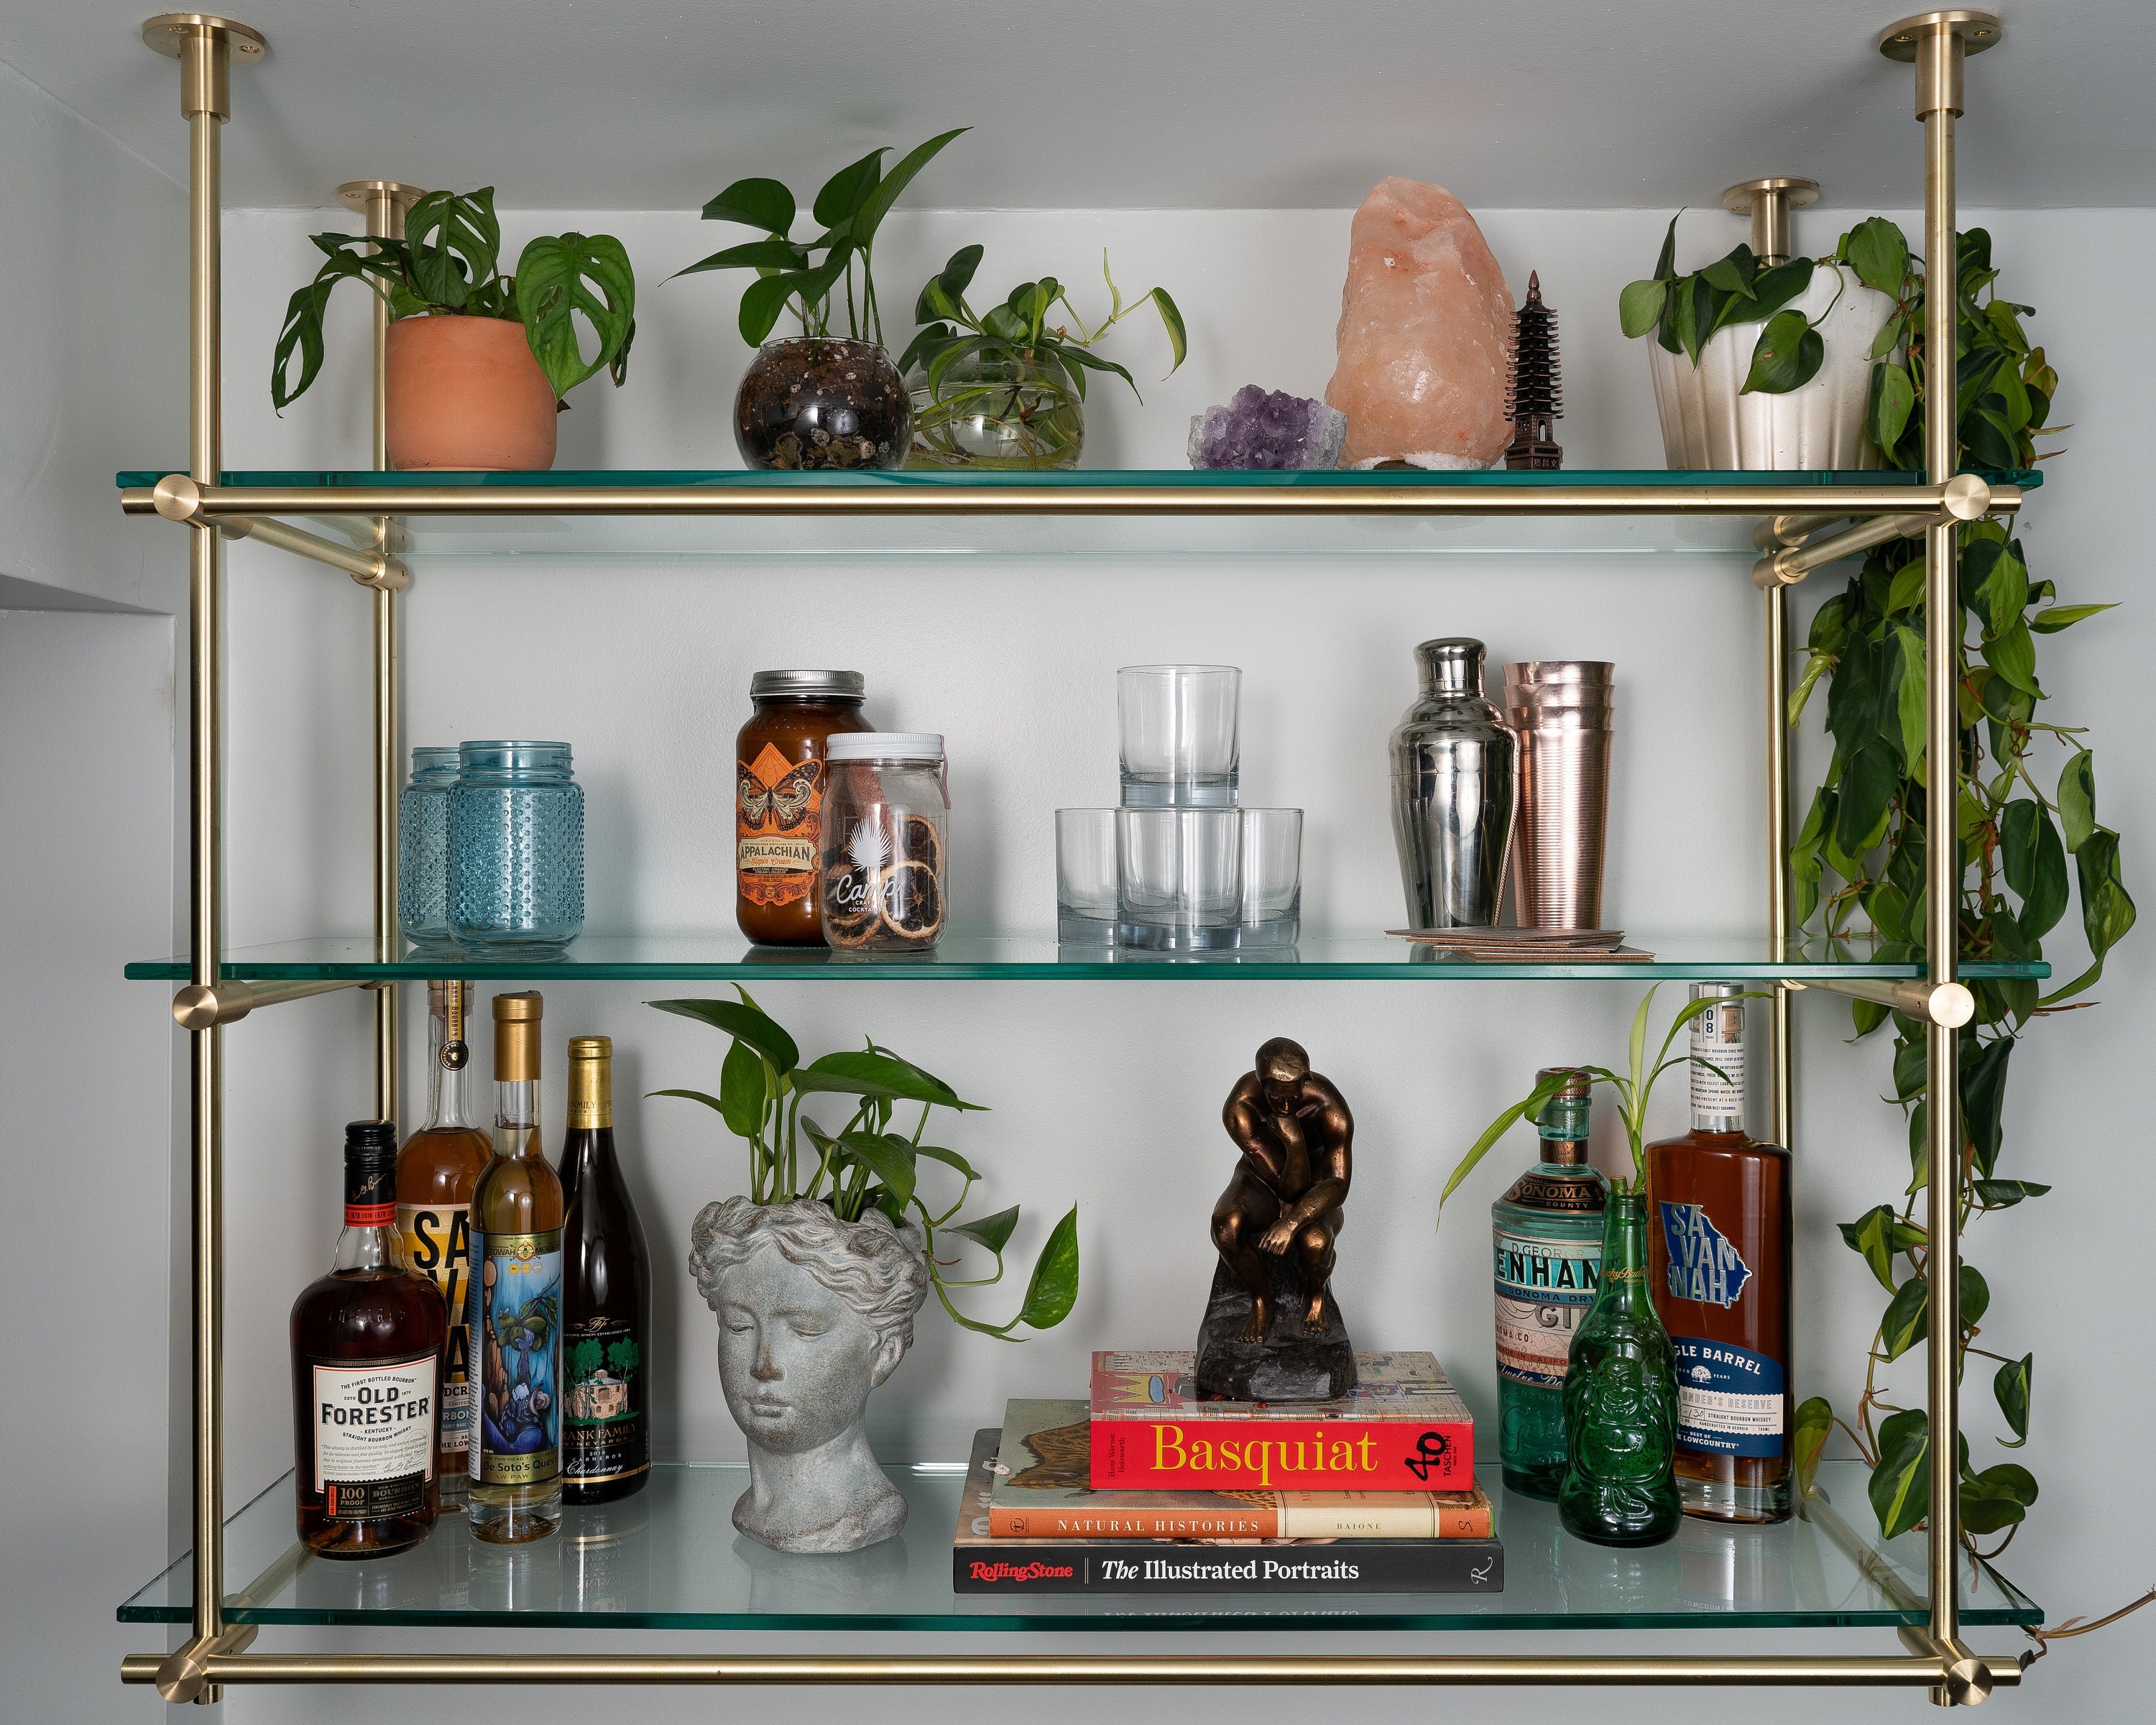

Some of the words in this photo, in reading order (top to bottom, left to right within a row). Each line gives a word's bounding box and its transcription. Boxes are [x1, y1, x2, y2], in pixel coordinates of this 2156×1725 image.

[740, 846, 811, 862] APPALACHIAN
[750, 857, 770, 866] Sippin'
[770, 857, 791, 866] Cream
[837, 874, 901, 907] Camp
[570, 1100, 596, 1109] FAMILY
[1506, 1179, 1592, 1200] SONOMA
[1671, 1205, 1705, 1238] SA
[1679, 1236, 1736, 1271] VAN
[1671, 1266, 1727, 1303] NAH
[1508, 1287, 1561, 1302] SONOMA
[1534, 1305, 1580, 1329] GI
[1496, 1325, 1513, 1338] NOMA
[1518, 1333, 1533, 1343] CO.
[1498, 1346, 1514, 1356] MADE
[1531, 1356, 1567, 1365] CALIFO
[1674, 1345, 1697, 1357] GLE
[1703, 1347, 1761, 1375] BARREL
[351, 1379, 367, 1388] FIRST
[444, 1386, 469, 1397] DCR
[357, 1386, 400, 1404] OLD
[1682, 1391, 1723, 1407] UNDER'S
[1728, 1398, 1772, 1409] RESERVE
[342, 1432, 367, 1443] STRAIGHT
[368, 1434, 393, 1443] BOURBON
[393, 1425, 412, 1438] WHISKY
[364, 1426, 393, 1435] KENTUCKY
[598, 1423, 635, 1439] FAMILY
[564, 1437, 628, 1447] VINEYARDS
[483, 1461, 495, 1471] De
[497, 1462, 530, 1472] Soto's
[533, 1456, 558, 1469] Quest
[572, 1453, 622, 1462] CARNEROS
[1150, 1425, 1378, 1486] Basquiat
[1404, 1431, 1446, 1481] 40
[566, 1460, 624, 1475] Chardonnay
[340, 1487, 365, 1499] 100
[1058, 1519, 1145, 1532] NATURAL
[1155, 1519, 1258, 1532] HISTORIES
[1102, 1560, 1138, 1581] The
[1143, 1560, 1256, 1580] Illustrated
[1263, 1560, 1360, 1580] Portraits
